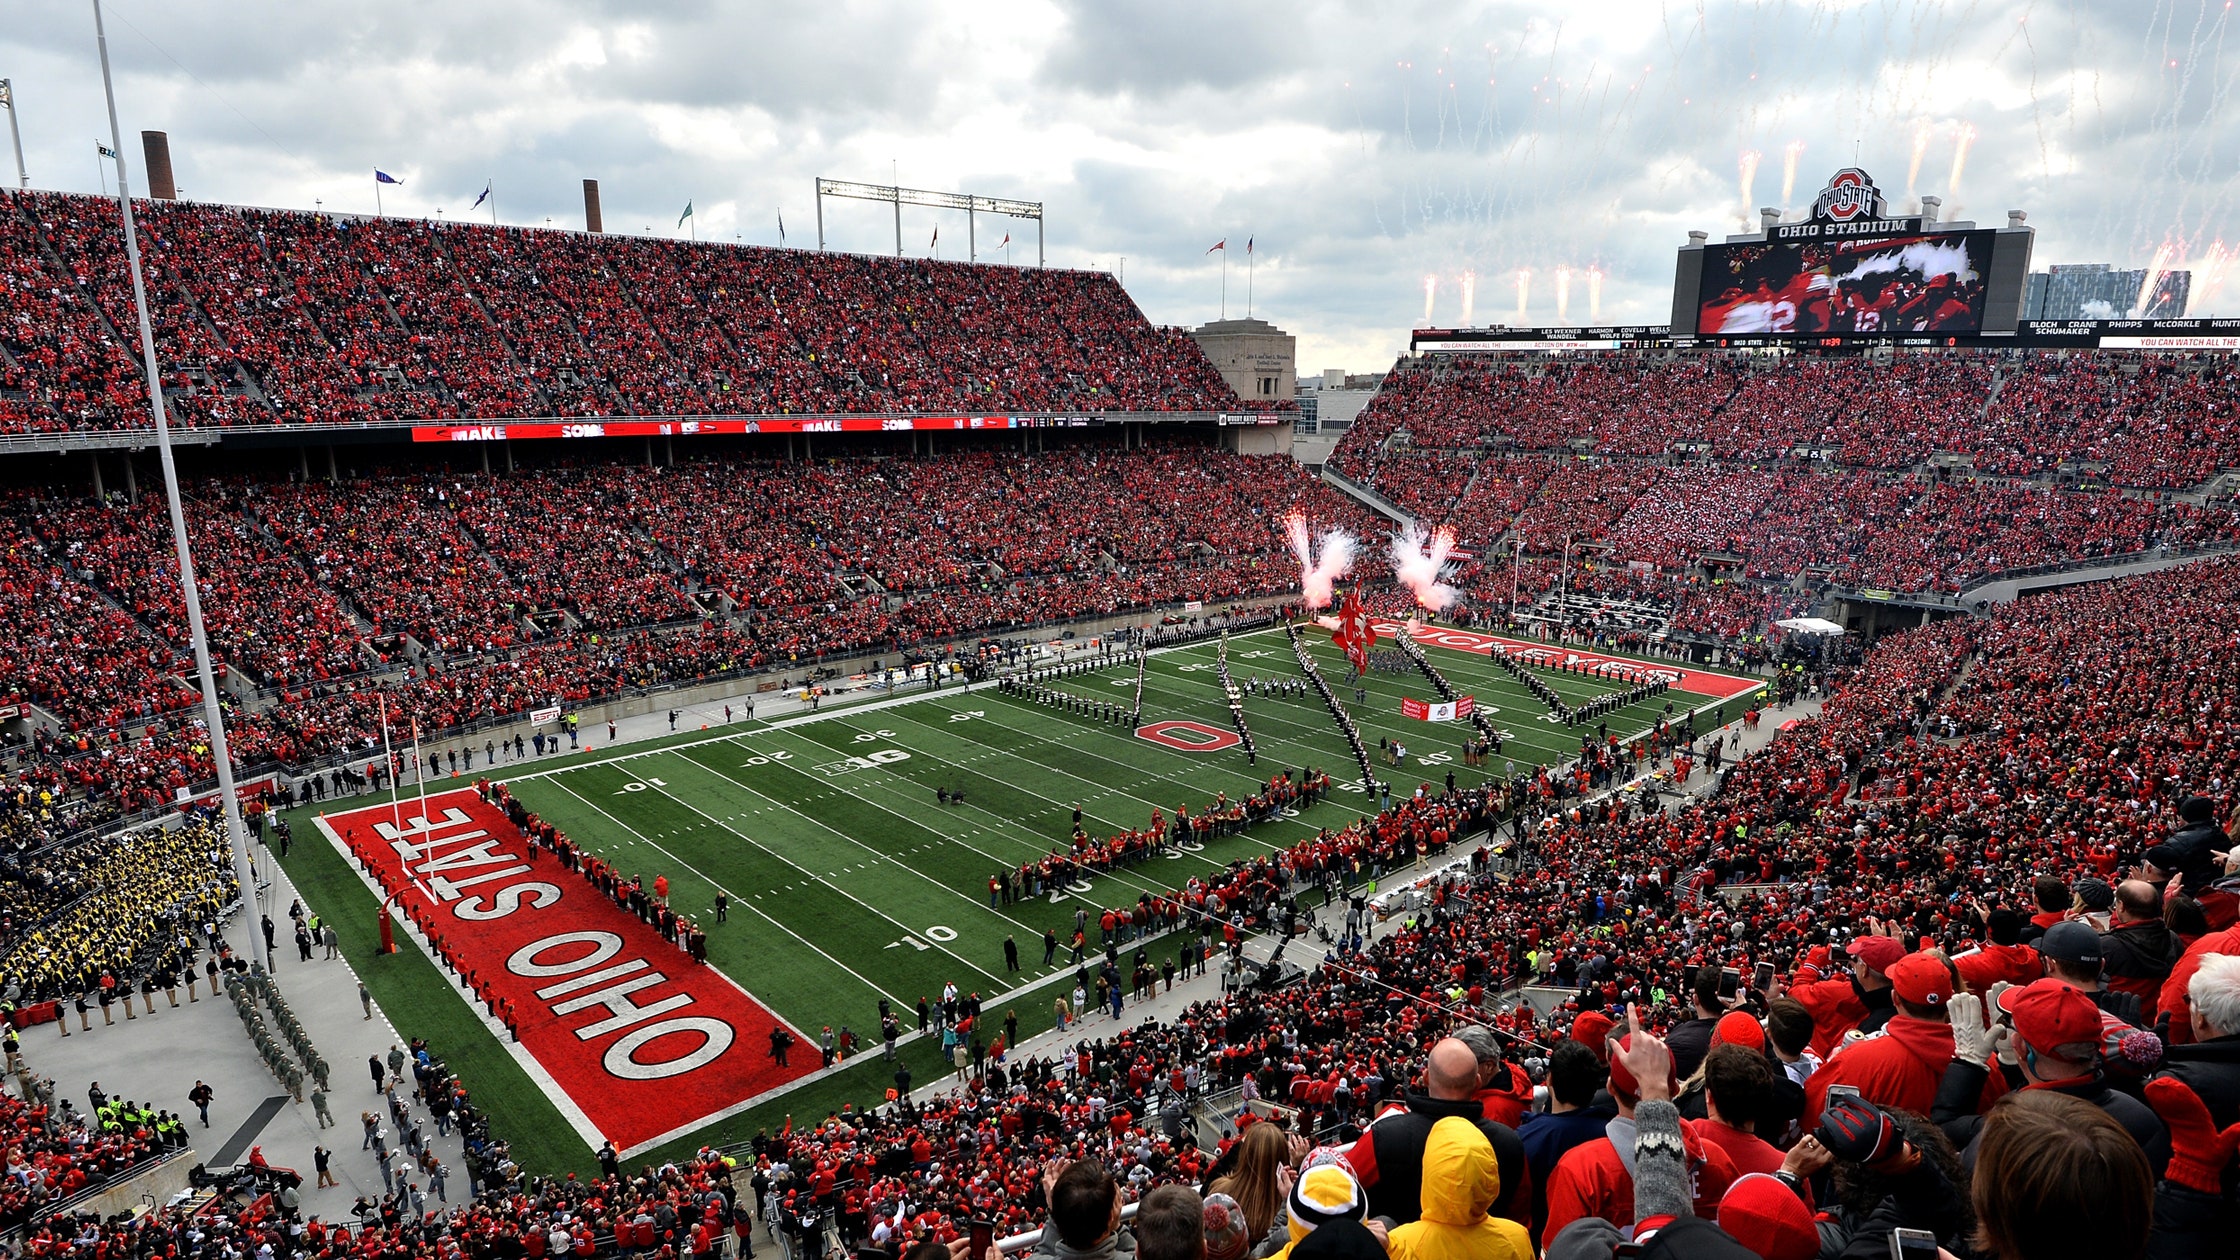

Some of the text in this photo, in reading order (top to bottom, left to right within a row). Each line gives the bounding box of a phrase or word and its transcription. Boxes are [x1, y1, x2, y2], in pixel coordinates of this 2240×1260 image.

[1818, 183, 1872, 219] OHIO STATE
[1778, 219, 1908, 239] OHIO STADIUM
[2108, 320, 2143, 328] PHIPPS
[2153, 320, 2201, 328] McCORKLE
[2140, 338, 2238, 346] YOU CAN WATCH ALL THE
[452, 426, 506, 441] MAKE
[802, 420, 842, 432] MAKE
[1403, 699, 1421, 709] Varsity
[533, 710, 560, 722] ESPN
[950, 710, 985, 721] 40
[1402, 710, 1421, 719] Society
[859, 728, 898, 744] 30
[747, 750, 795, 766] 20
[1417, 752, 1454, 767] 40
[623, 777, 669, 794] 10
[372, 806, 563, 922] STATE
[901, 925, 959, 952] 10
[505, 929, 737, 1081] OHIO
[1073, 1111, 1080, 1121] 5
